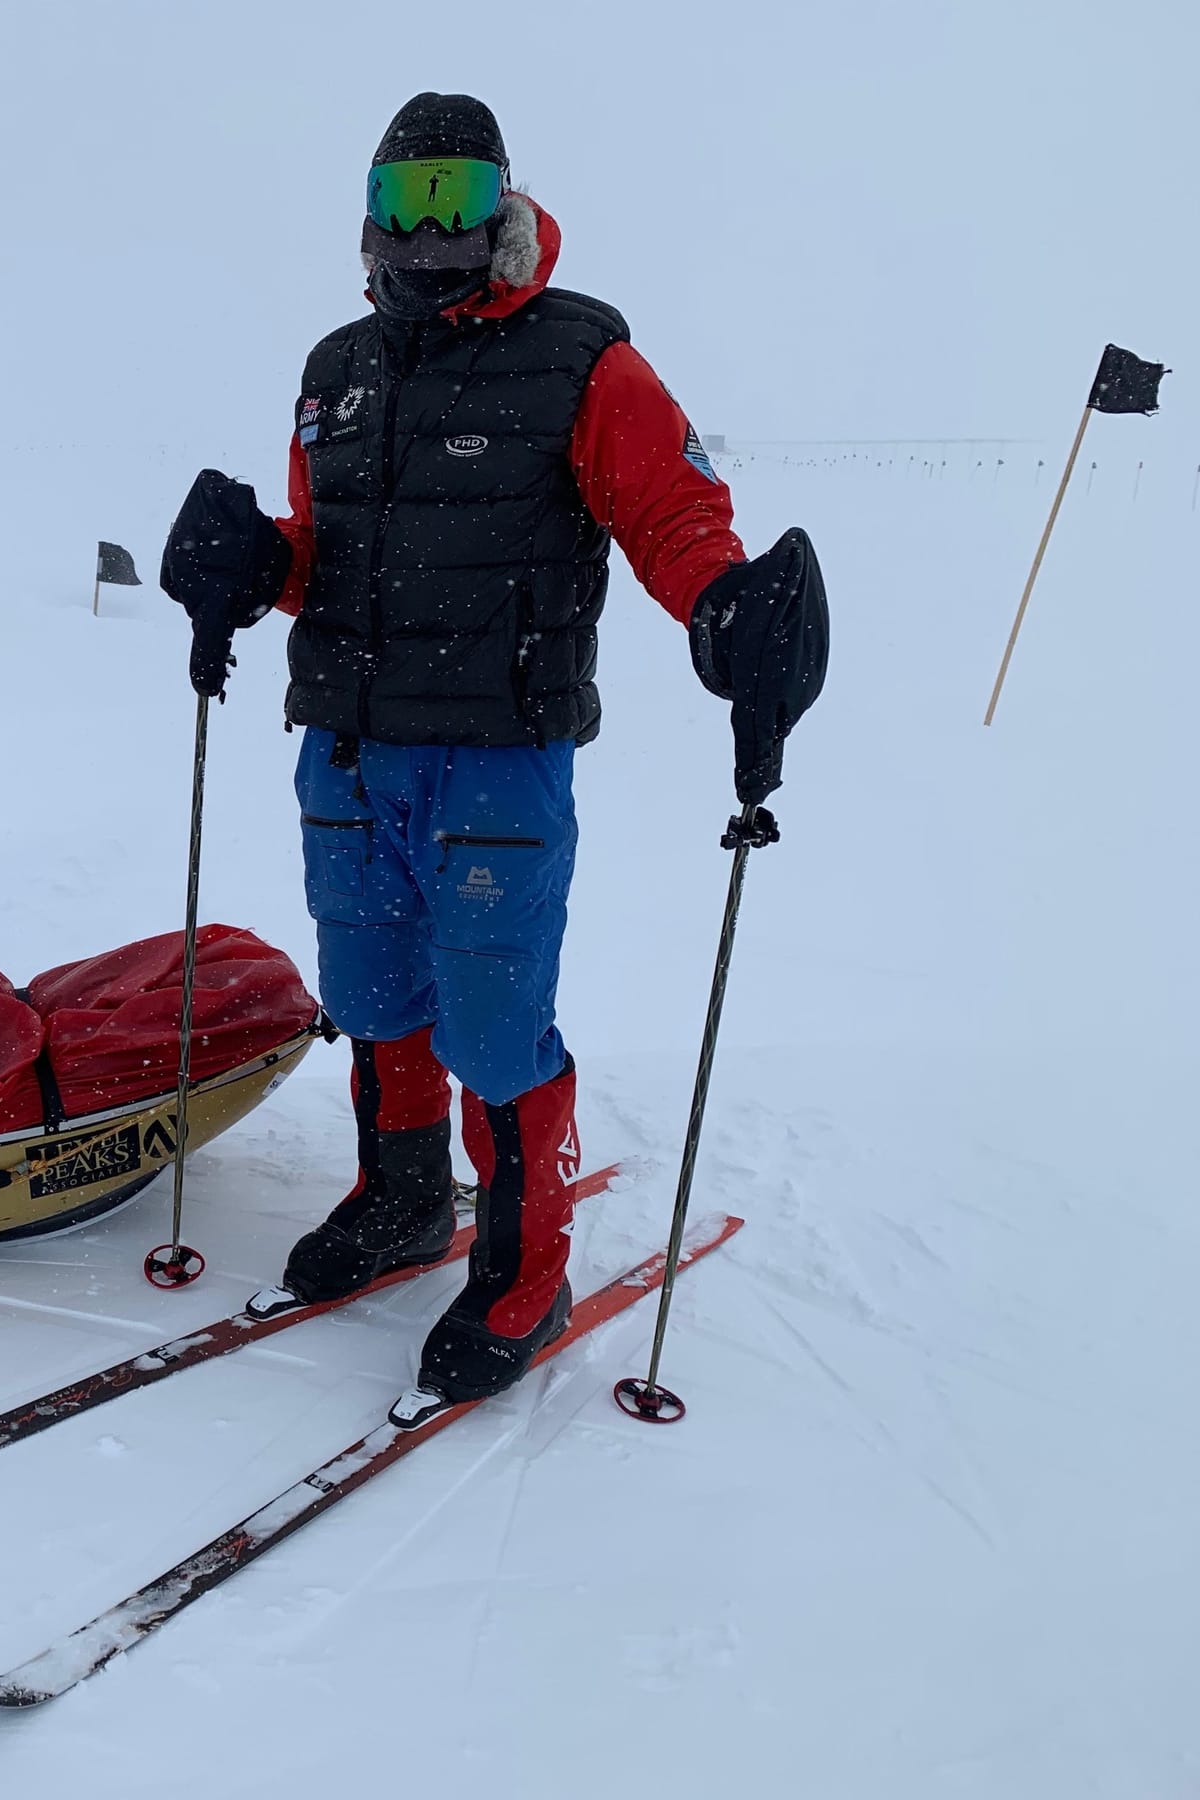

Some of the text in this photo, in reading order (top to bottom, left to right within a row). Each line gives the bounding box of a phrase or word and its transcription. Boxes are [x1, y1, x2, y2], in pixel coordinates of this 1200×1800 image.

[454, 439, 481, 447] PHD
[456, 884, 504, 896] MOUNTAIN
[42, 1143, 130, 1184] PEAKS
[42, 1164, 131, 1193] ASSOCIATES
[488, 1346, 510, 1359] ALFA
